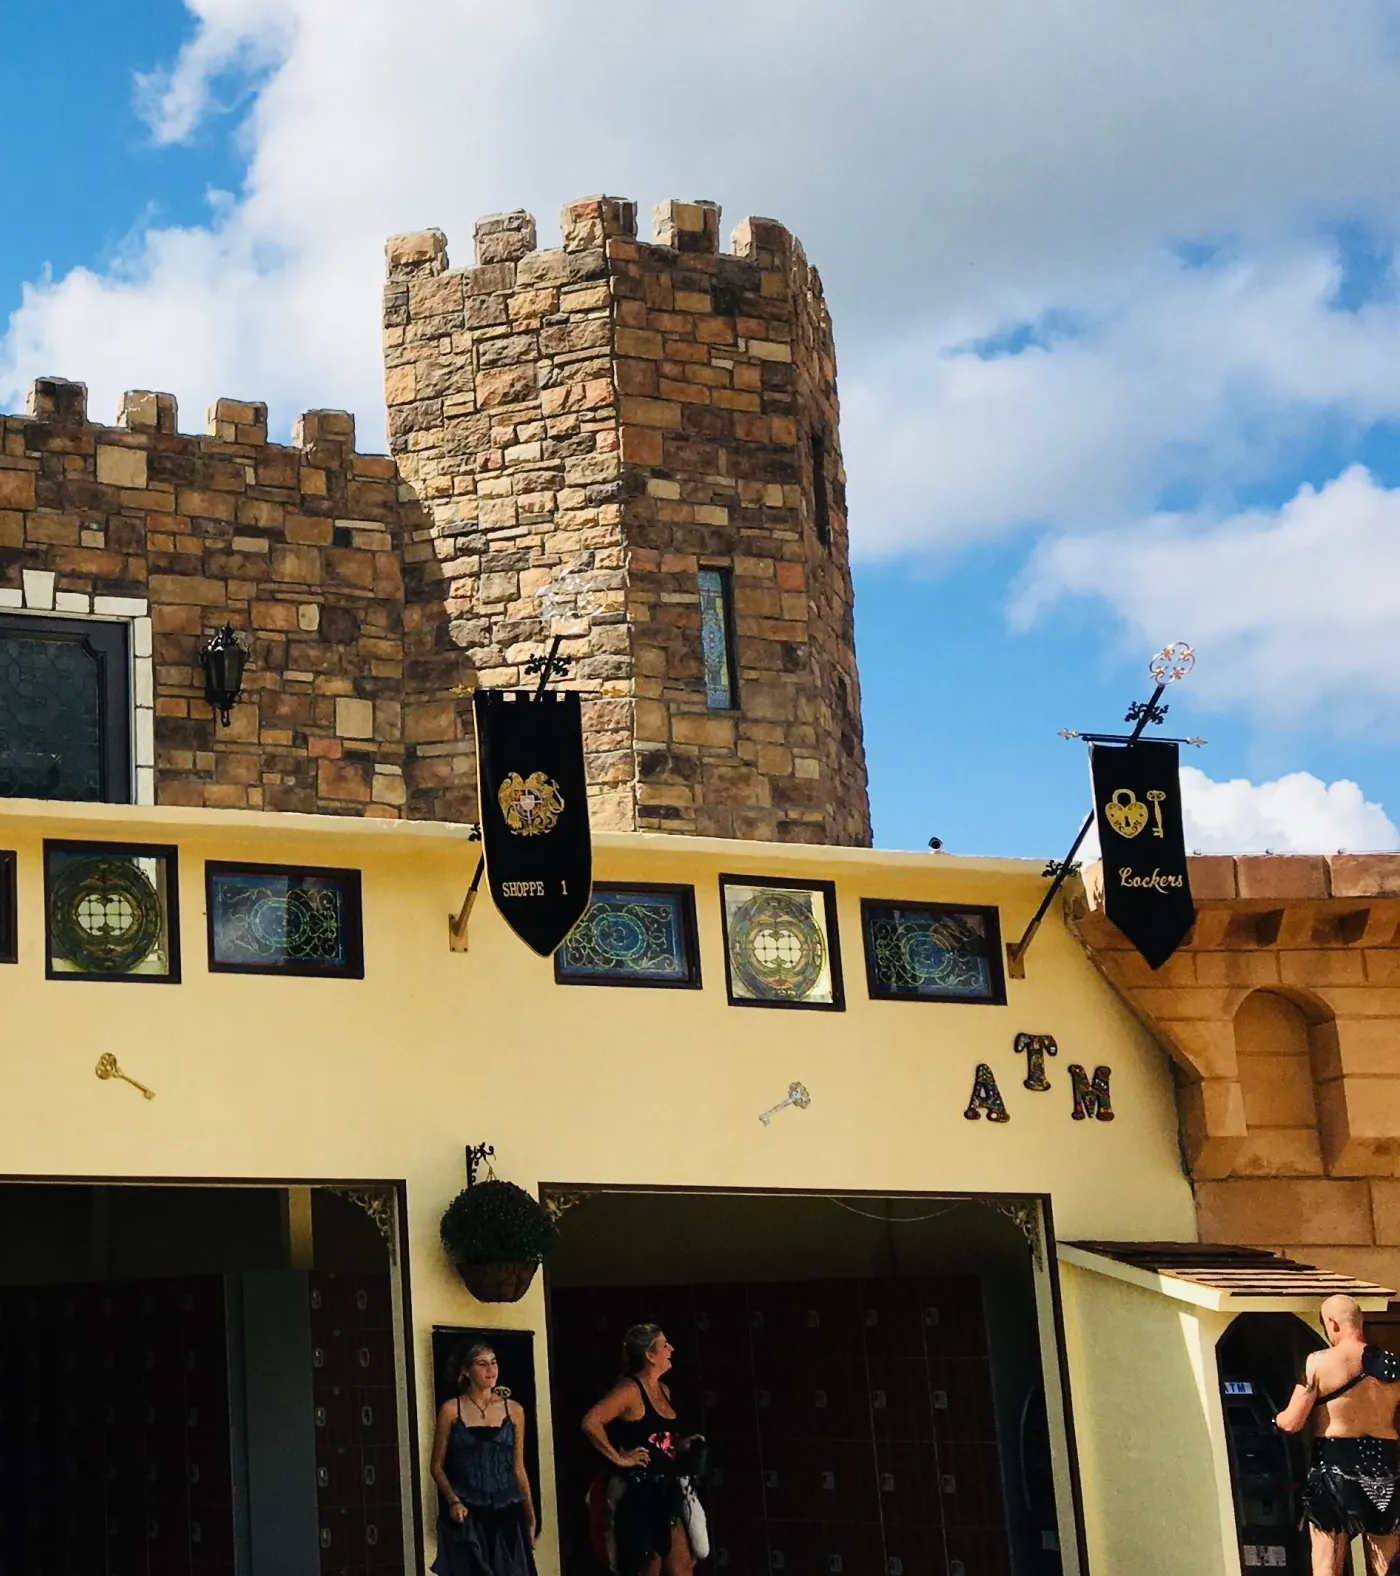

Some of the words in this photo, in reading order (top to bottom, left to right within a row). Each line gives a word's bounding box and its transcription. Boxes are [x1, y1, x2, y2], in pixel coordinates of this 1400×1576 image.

[502, 881, 544, 897] SHOPPE
[561, 879, 569, 895] 1
[1119, 867, 1183, 894] Lockers
[963, 1032, 1115, 1123] ATM
